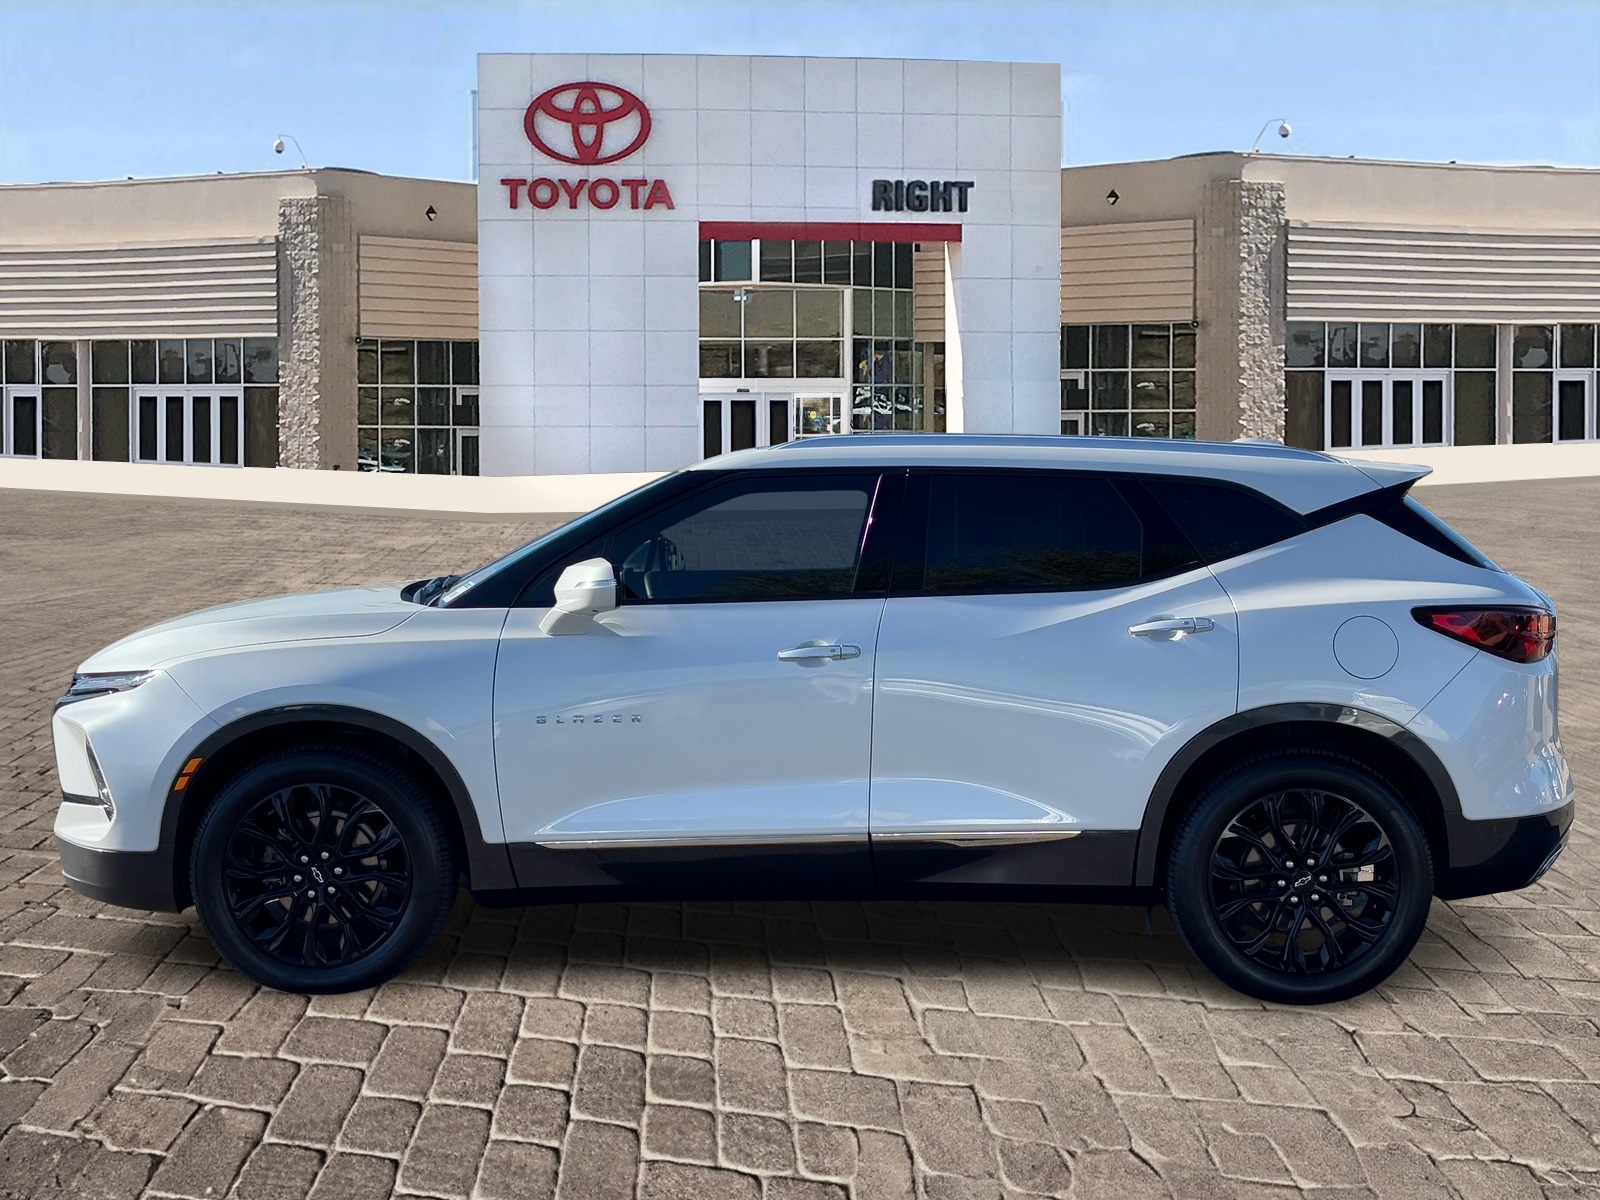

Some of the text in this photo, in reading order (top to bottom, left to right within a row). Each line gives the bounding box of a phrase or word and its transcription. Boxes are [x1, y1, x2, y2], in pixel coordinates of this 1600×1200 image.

[500, 178, 676, 210] TOYOTA
[871, 179, 975, 213] RIGHT
[536, 714, 642, 725] BLAZER
